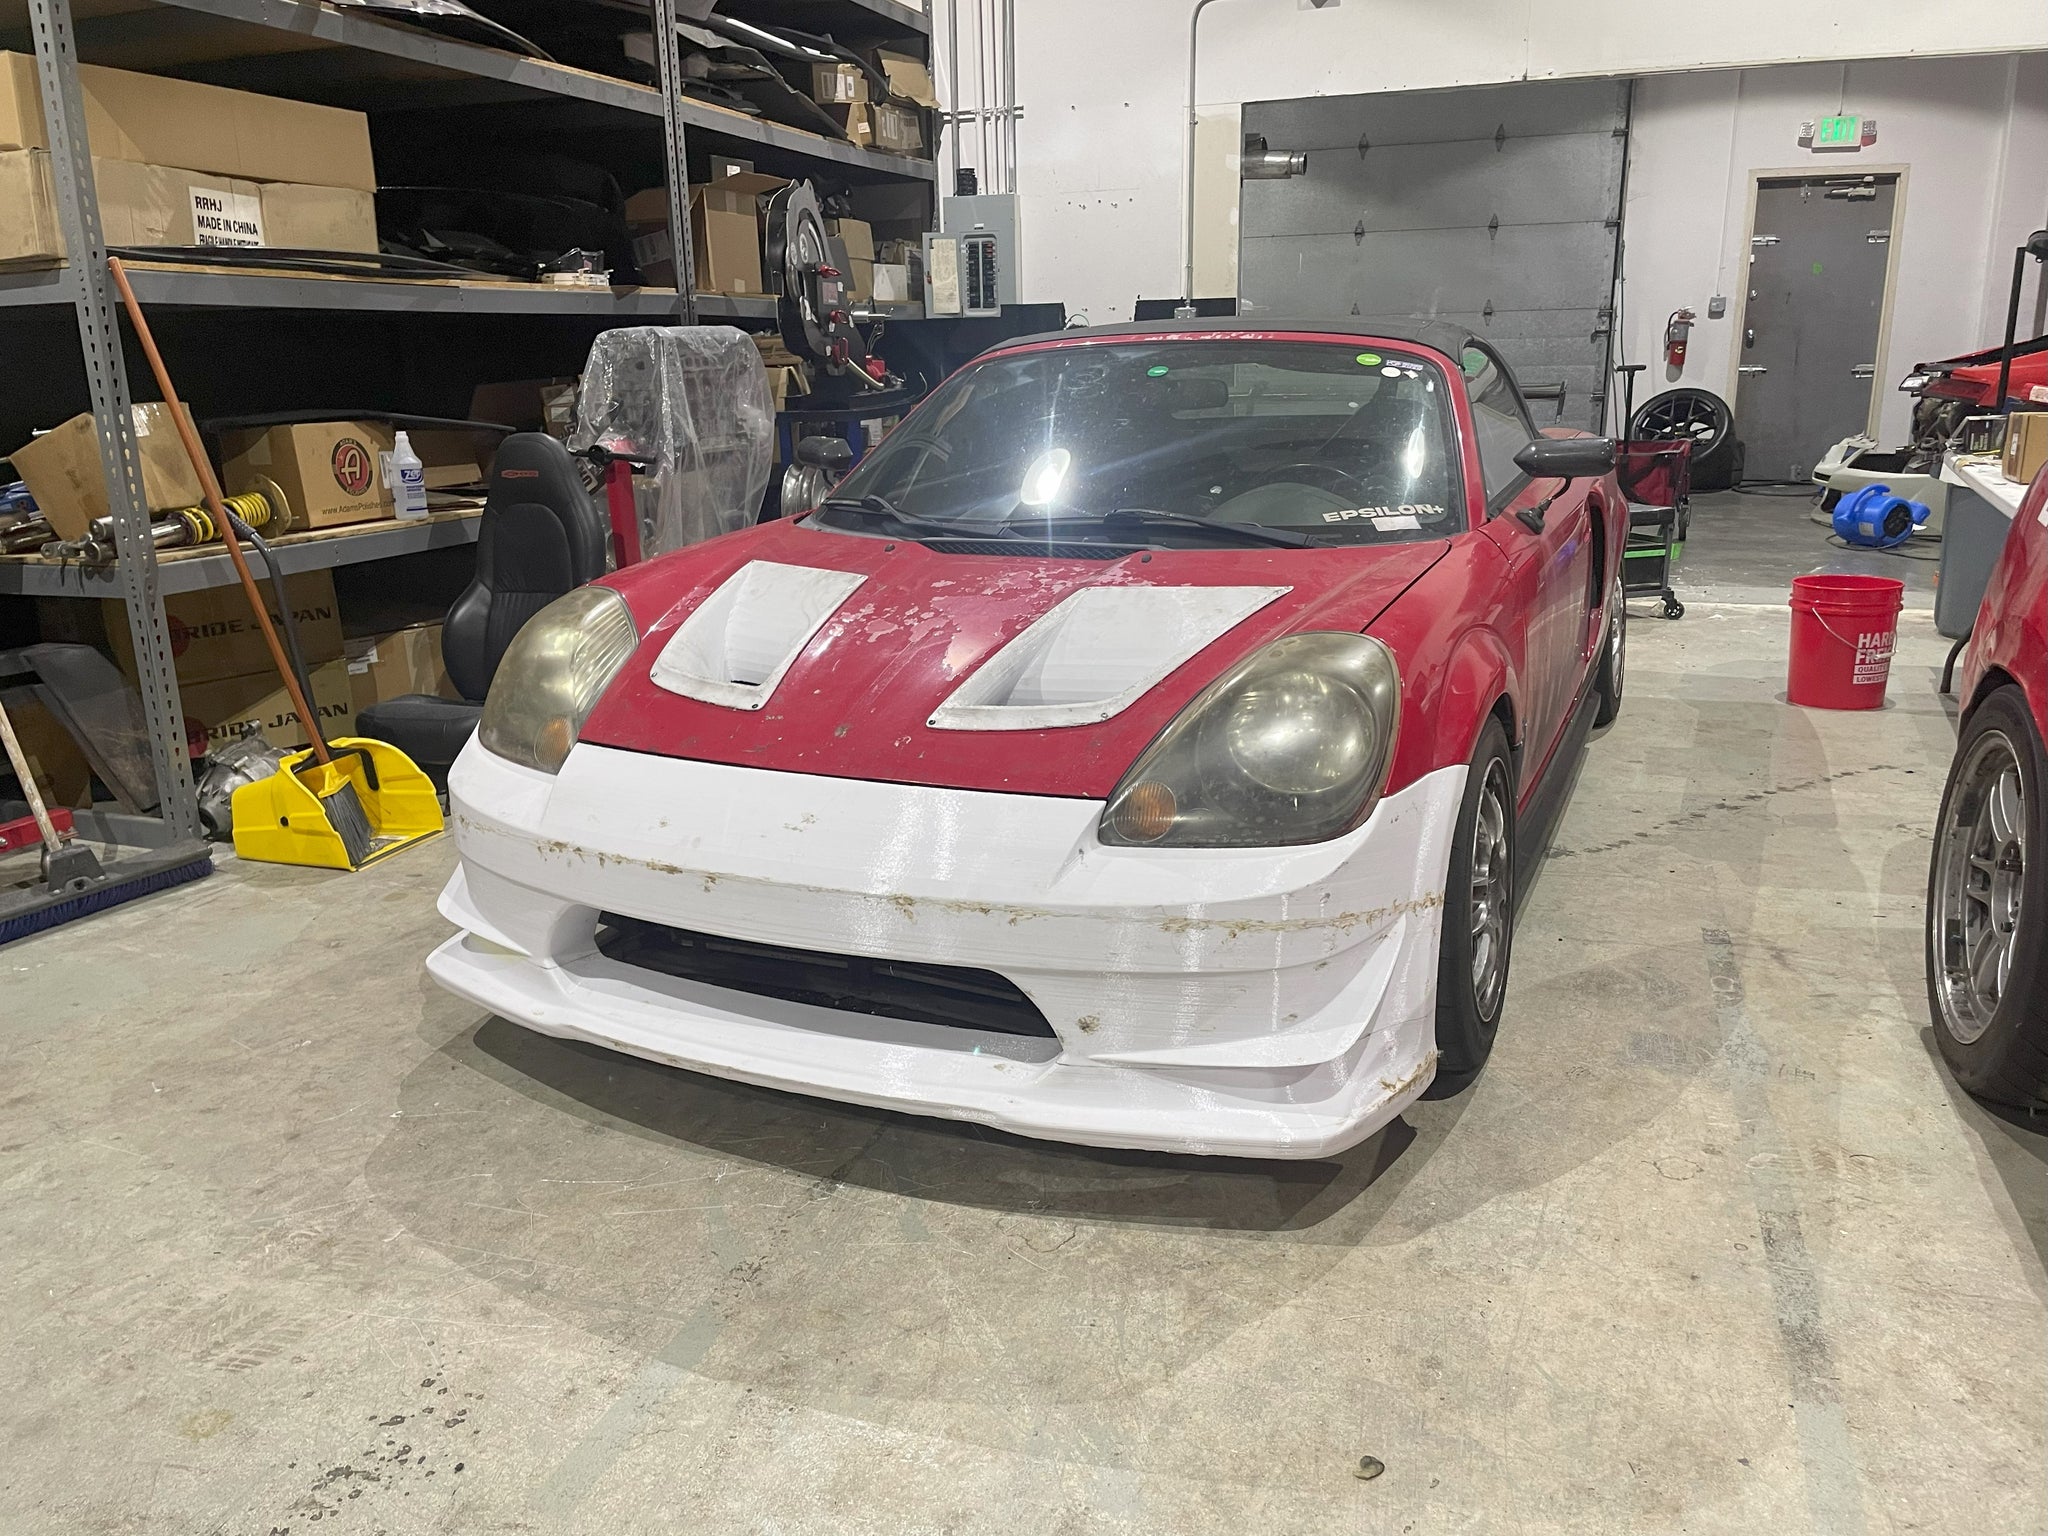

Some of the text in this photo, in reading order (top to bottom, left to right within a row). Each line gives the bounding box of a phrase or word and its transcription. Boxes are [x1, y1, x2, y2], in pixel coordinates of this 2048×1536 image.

[1821, 117, 1857, 142] EXIT
[194, 195, 223, 213] RRHJ
[197, 214, 259, 237] MADE IN CHINA
[1322, 503, 1445, 523] EPSILON+
[268, 702, 349, 728] JAAN
